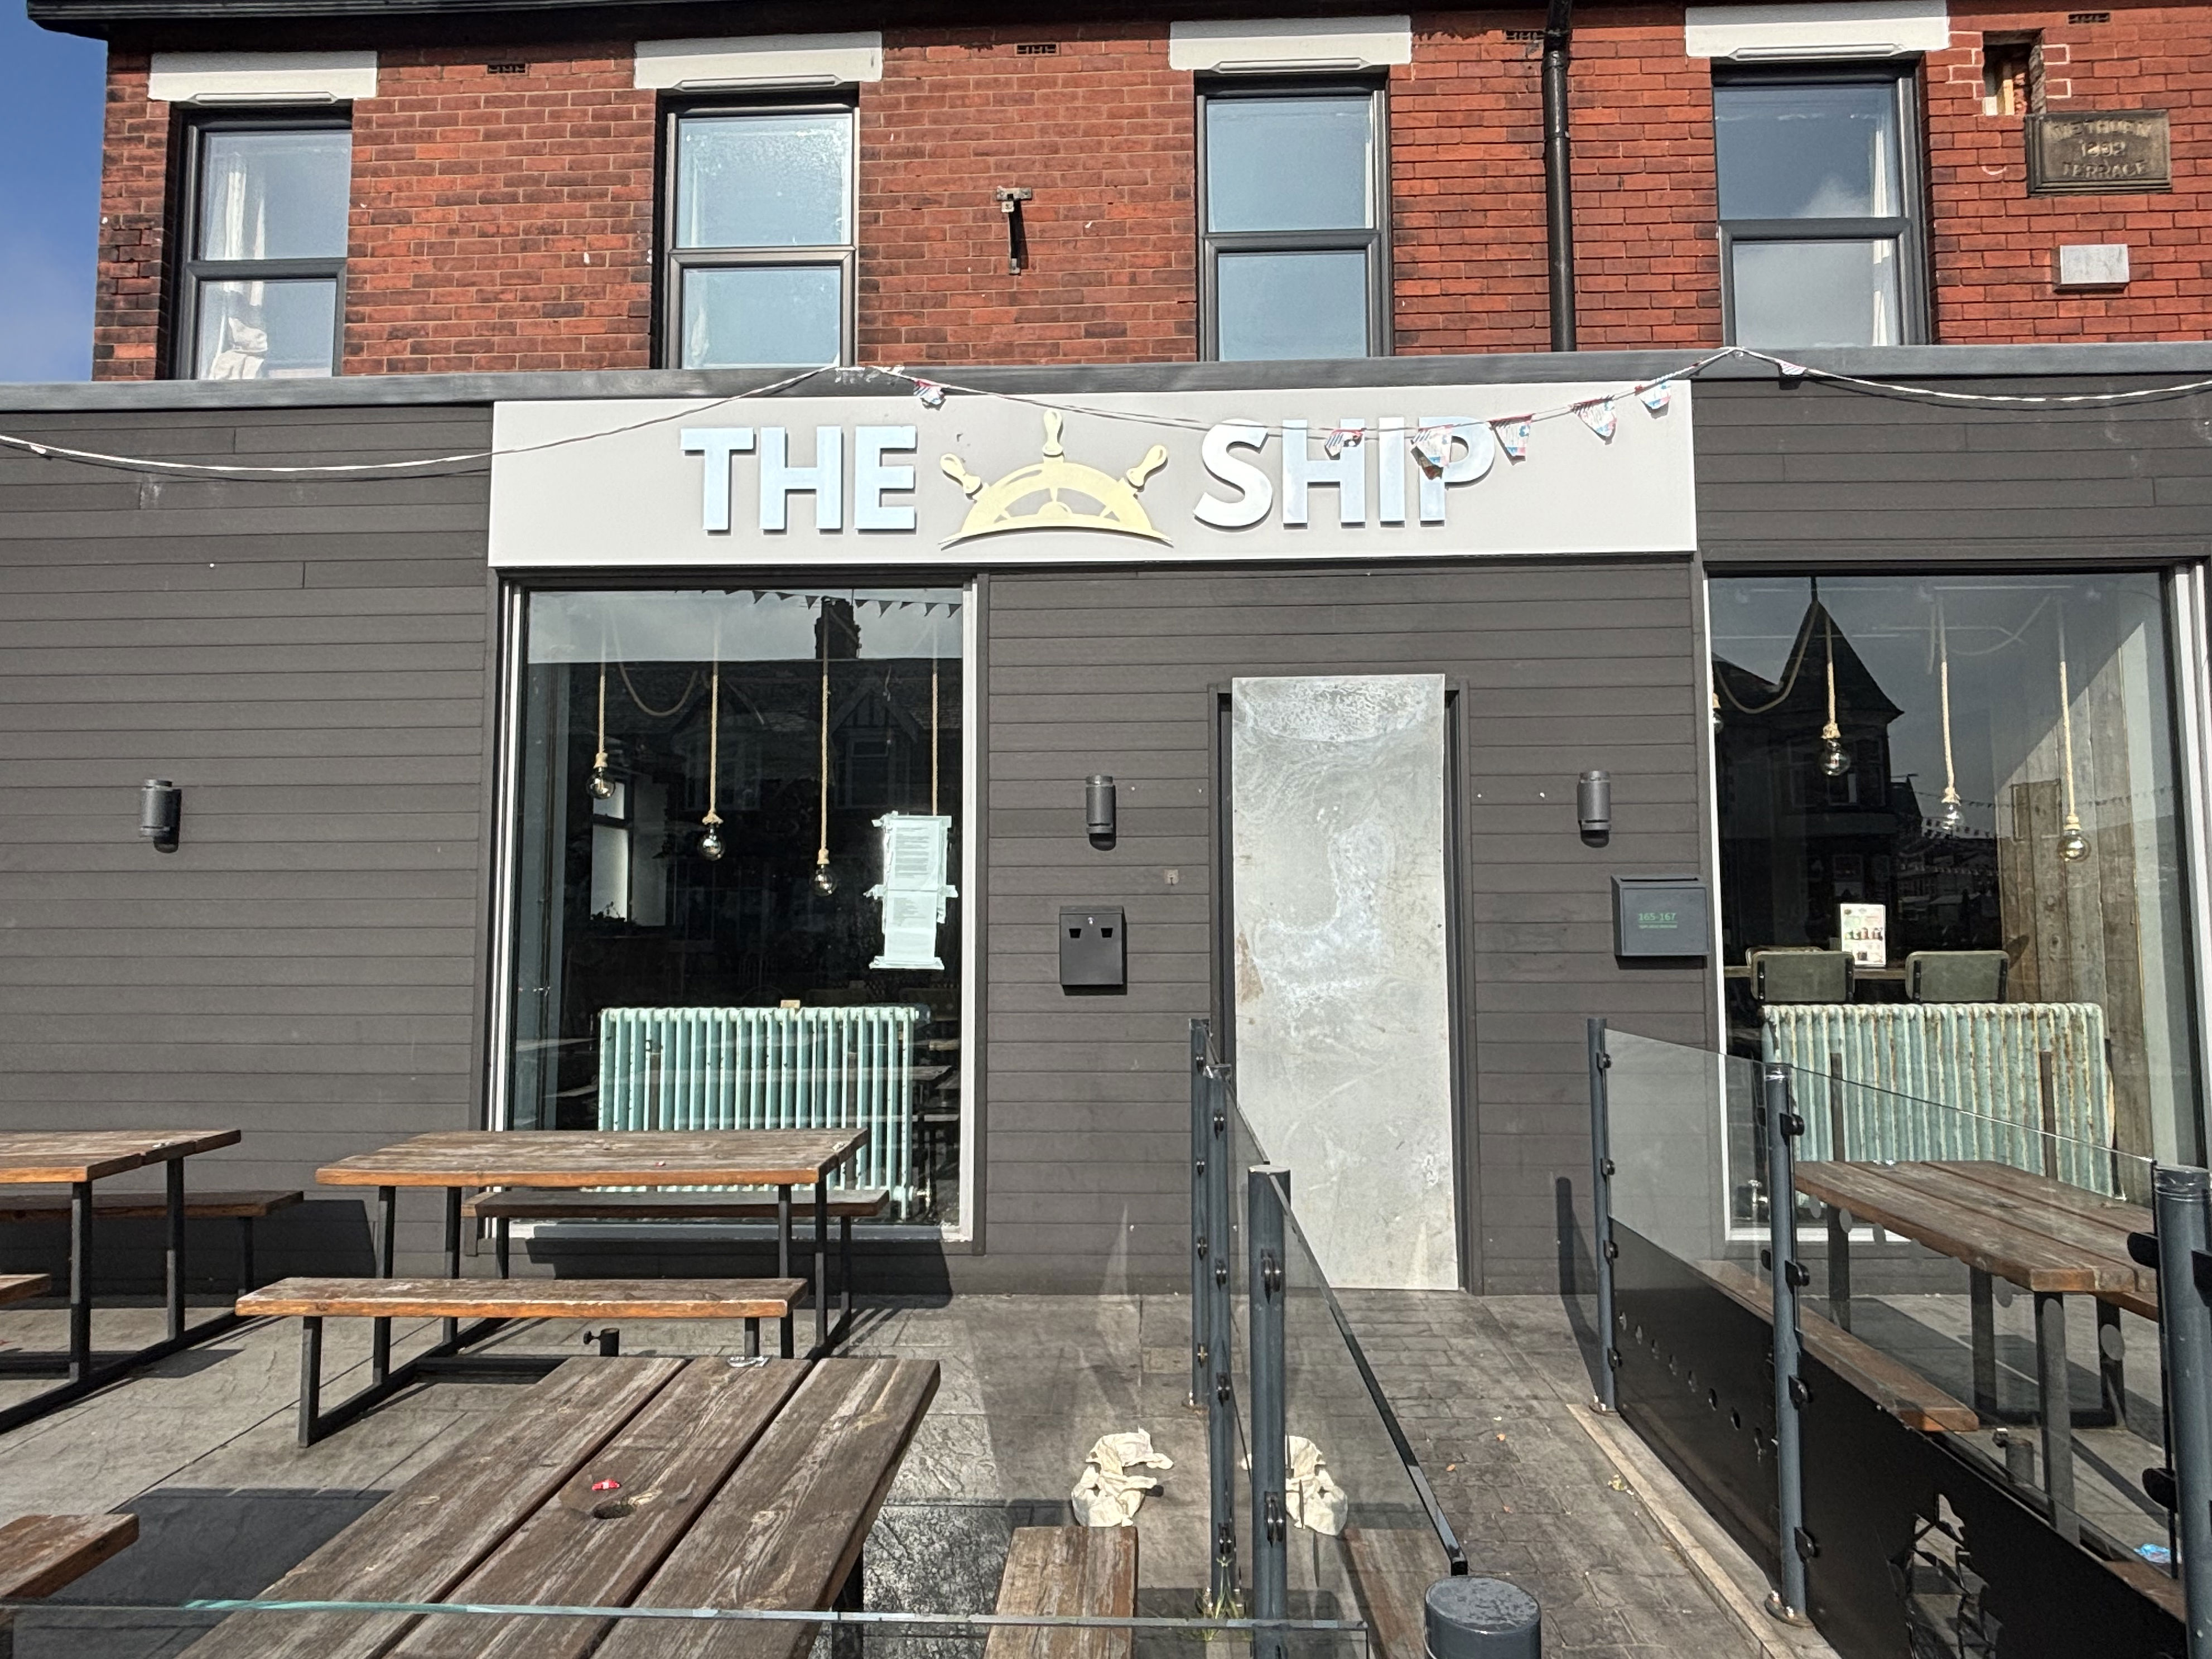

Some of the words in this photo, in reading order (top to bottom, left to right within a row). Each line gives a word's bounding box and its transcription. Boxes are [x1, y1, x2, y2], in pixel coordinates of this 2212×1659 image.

[2079, 139, 2126, 157] 1892
[2062, 160, 2147, 179] TERRACE
[681, 425, 917, 532] THE
[1193, 415, 1496, 527] SHIP
